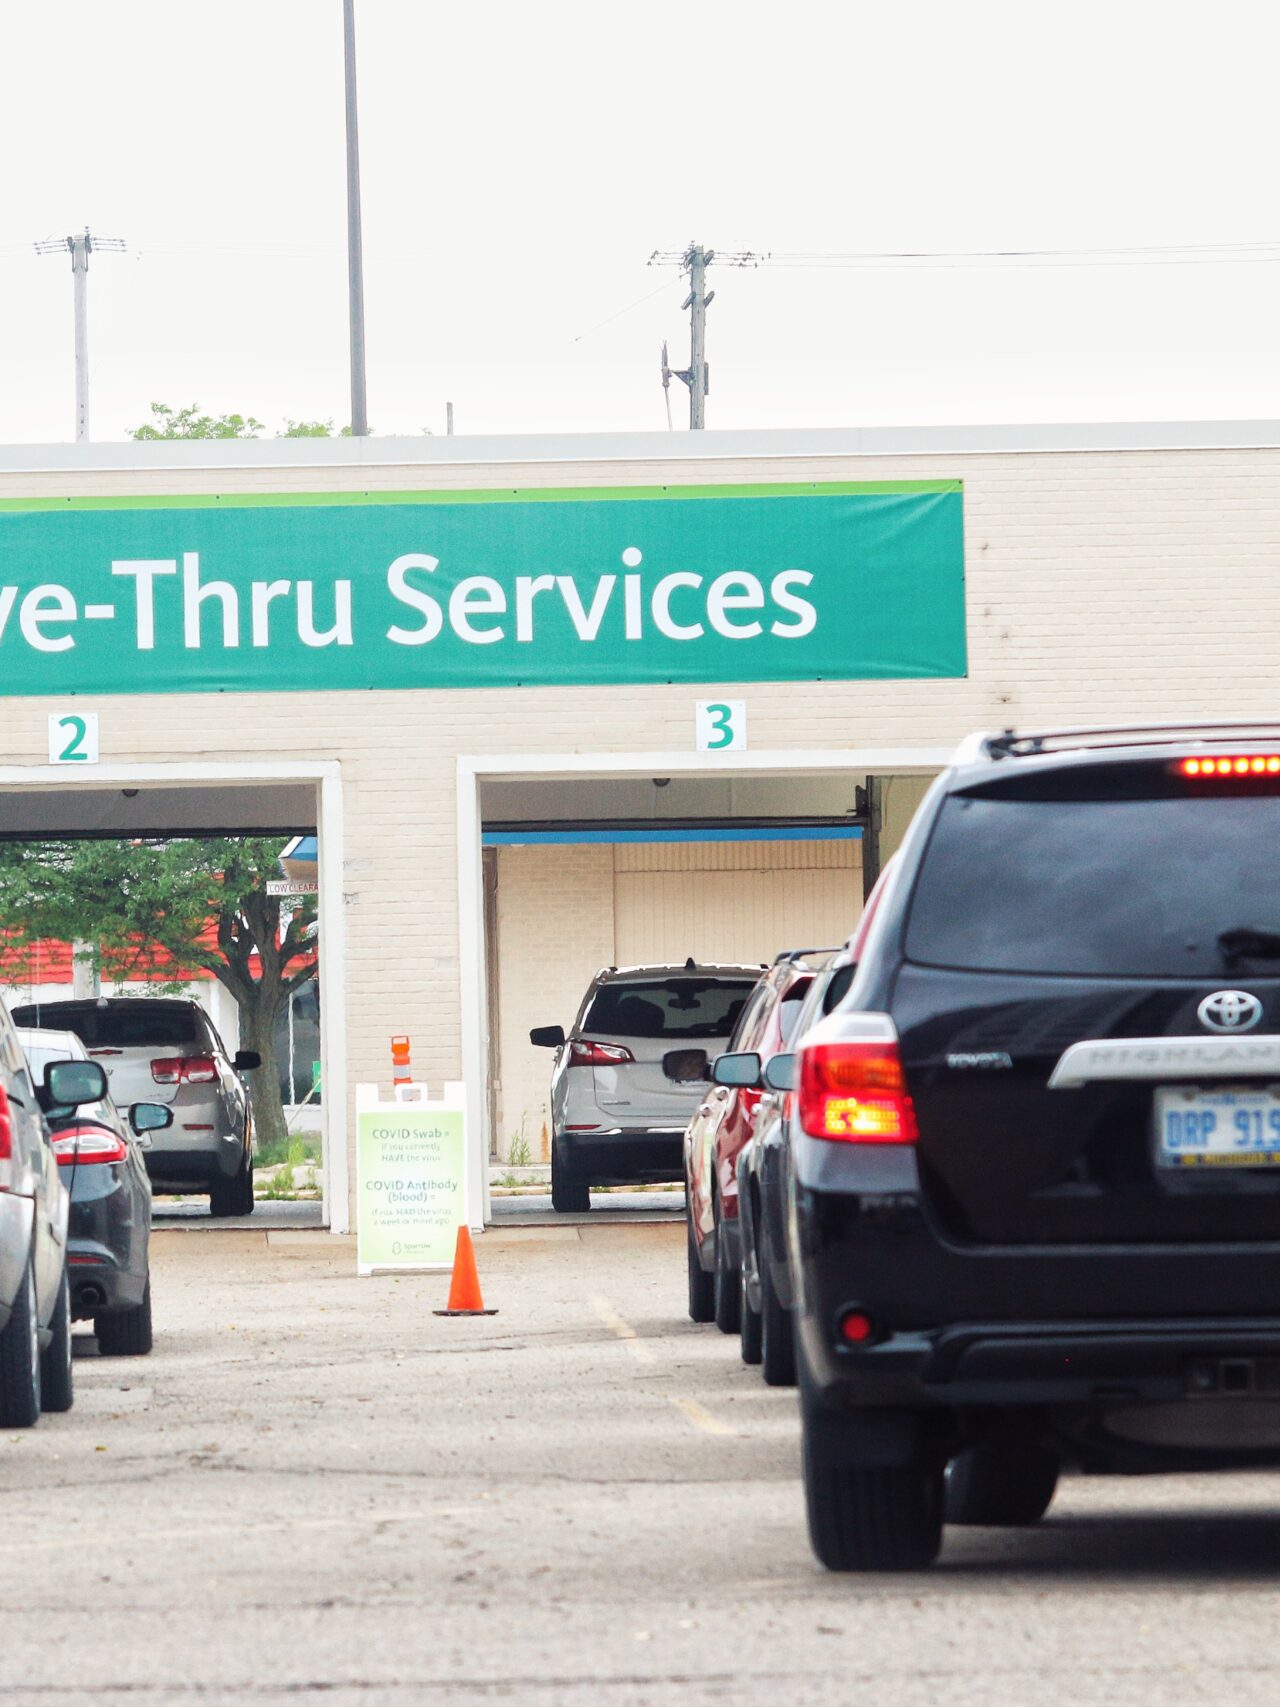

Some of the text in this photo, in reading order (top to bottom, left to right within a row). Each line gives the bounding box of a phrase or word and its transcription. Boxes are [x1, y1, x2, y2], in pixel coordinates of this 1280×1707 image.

[386, 547, 817, 646] Services
[706, 703, 735, 749] 3
[58, 716, 89, 761] 2
[269, 884, 288, 893] LOW
[1089, 1046, 1280, 1065] HIGHLAN
[372, 1128, 410, 1139] COVID
[413, 1127, 442, 1138] Swab
[381, 1154, 404, 1162] HAVE
[406, 1153, 420, 1162] the
[365, 1179, 458, 1192] COVID Antibody
[388, 1191, 428, 1204] (blood)
[396, 1208, 415, 1216] HAD
[417, 1208, 430, 1216] the
